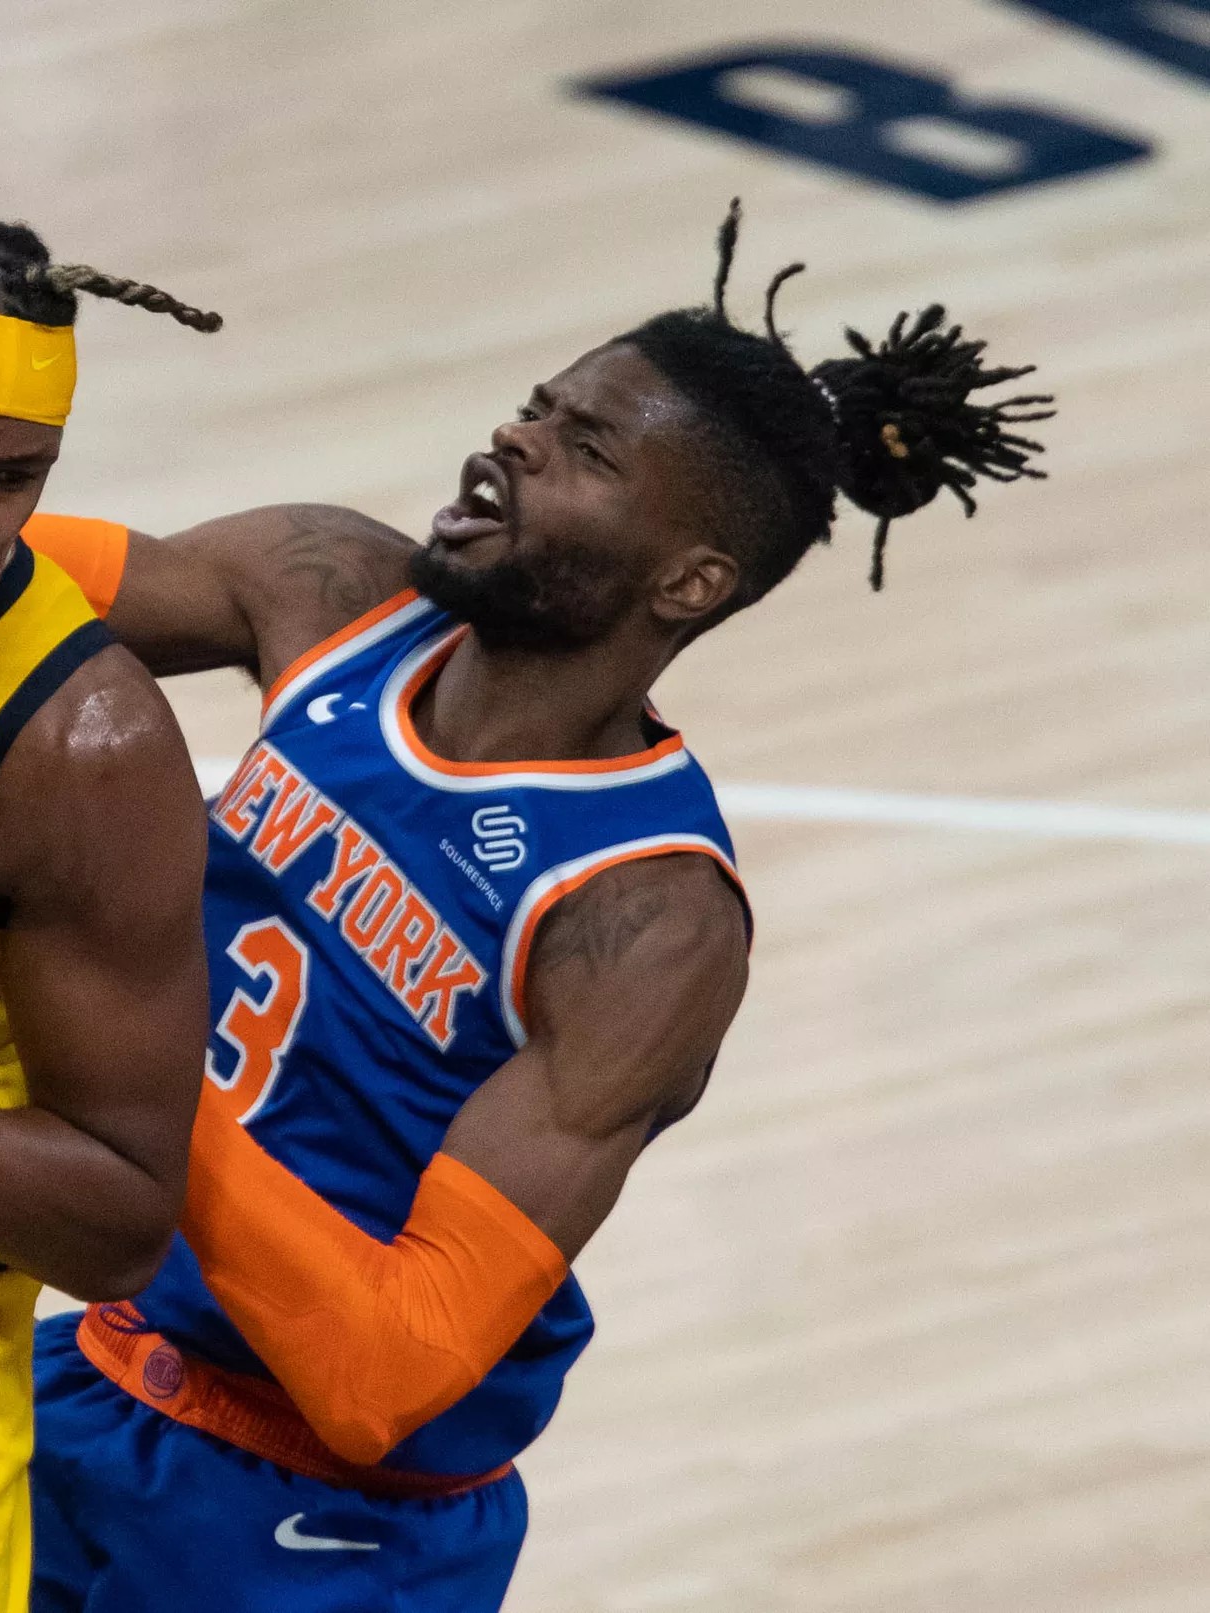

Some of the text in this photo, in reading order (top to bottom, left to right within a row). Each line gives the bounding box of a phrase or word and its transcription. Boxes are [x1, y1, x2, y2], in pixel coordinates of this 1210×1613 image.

[555, 0, 1210, 207] B
[304, 815, 489, 1053] YORK
[439, 838, 504, 912] SQUARESPACE
[205, 916, 310, 1125] 3
